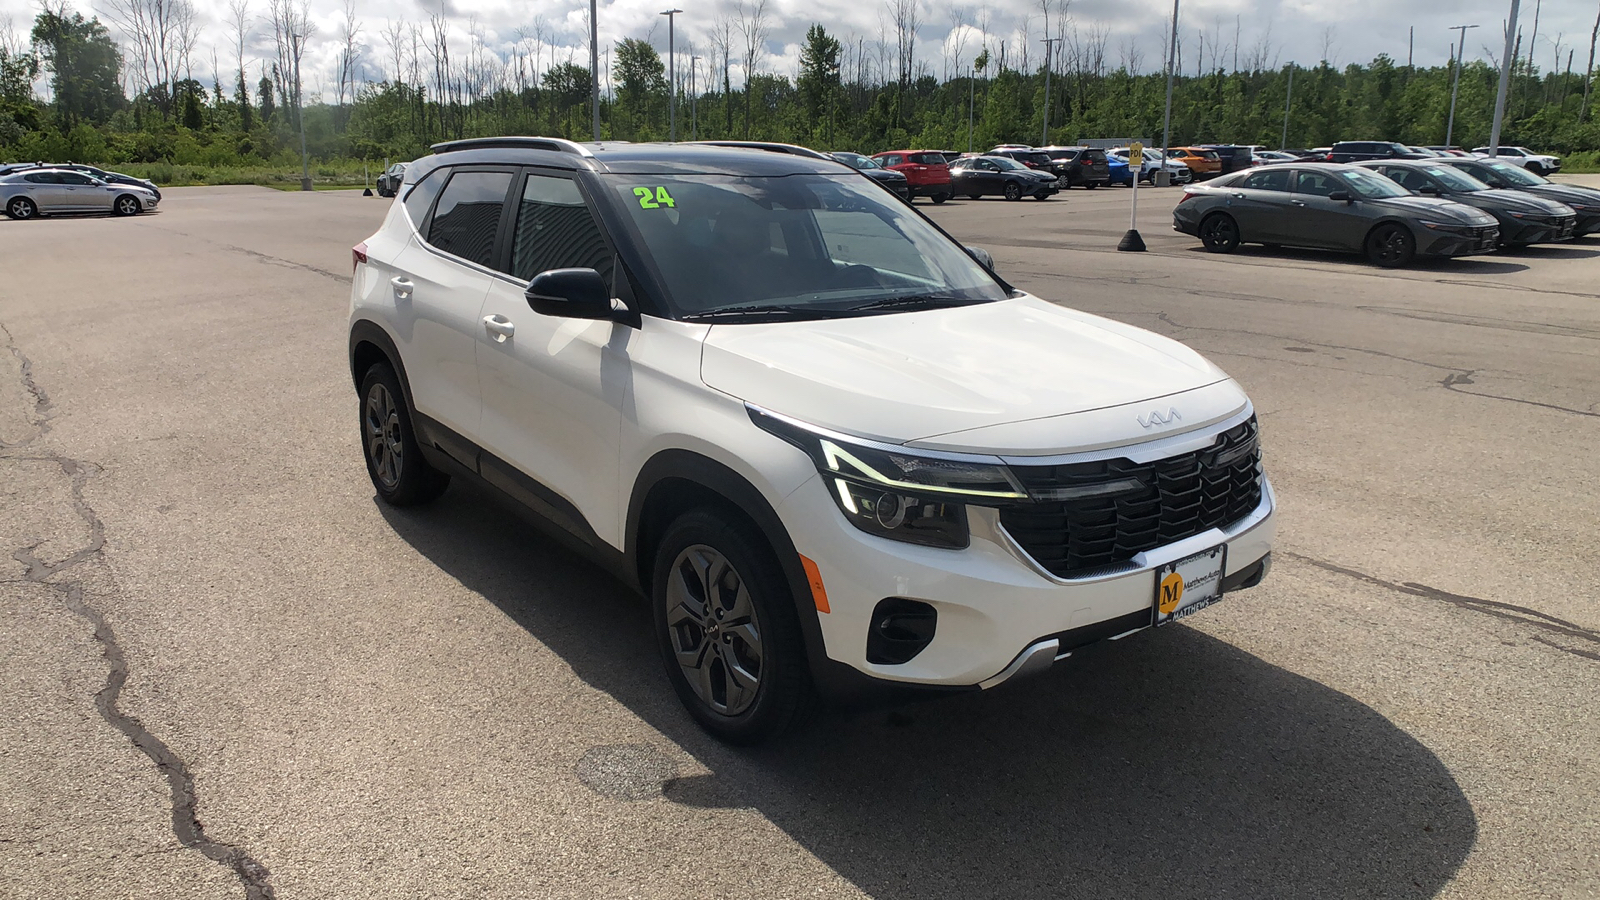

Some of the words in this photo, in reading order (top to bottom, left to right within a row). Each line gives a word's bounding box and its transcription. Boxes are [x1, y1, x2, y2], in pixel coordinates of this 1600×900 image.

[1130, 149, 1141, 158] PDI
[633, 186, 675, 209] 24
[1160, 581, 1179, 606] M
[1183, 576, 1208, 590] Matthews
[1172, 598, 1210, 622] MATTHEWS
